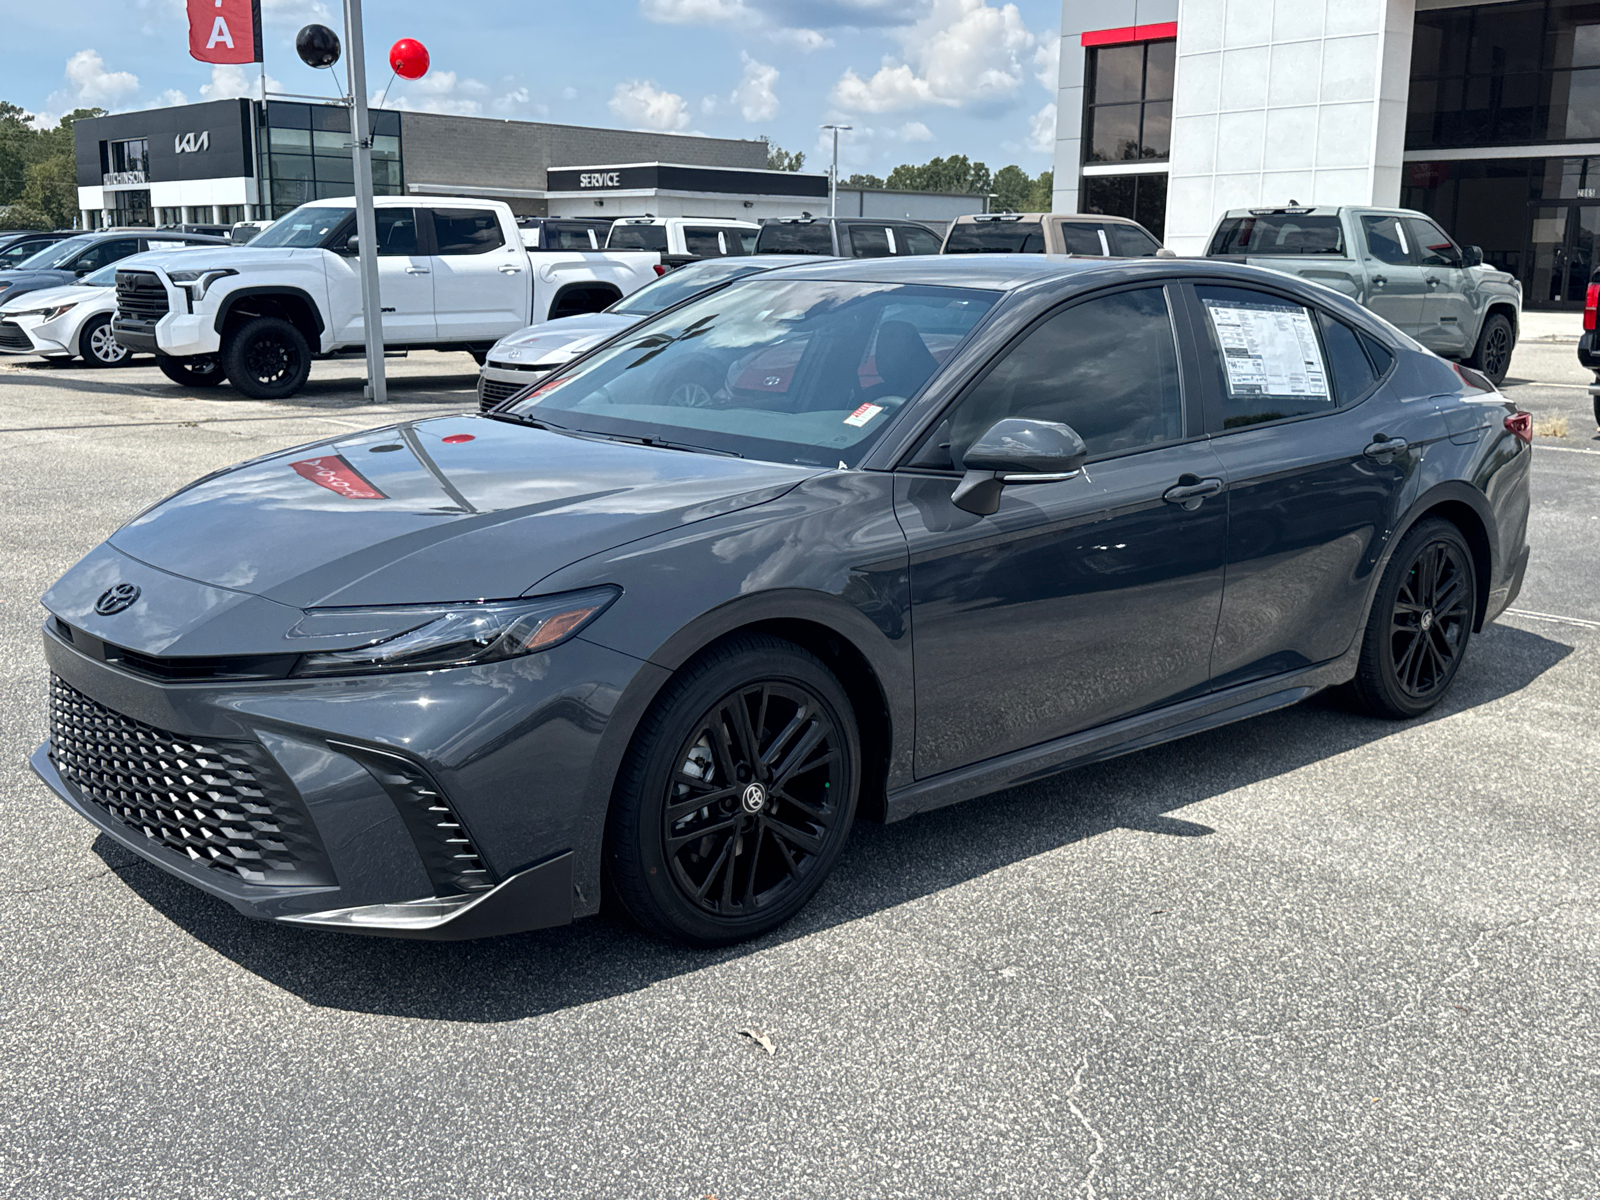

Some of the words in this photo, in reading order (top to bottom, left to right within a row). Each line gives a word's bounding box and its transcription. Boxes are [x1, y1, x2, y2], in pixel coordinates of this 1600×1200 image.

[206, 0, 235, 49] A
[174, 130, 209, 154] KIA
[103, 171, 145, 186] HUTCHINSON
[580, 172, 620, 188] SERVICE
